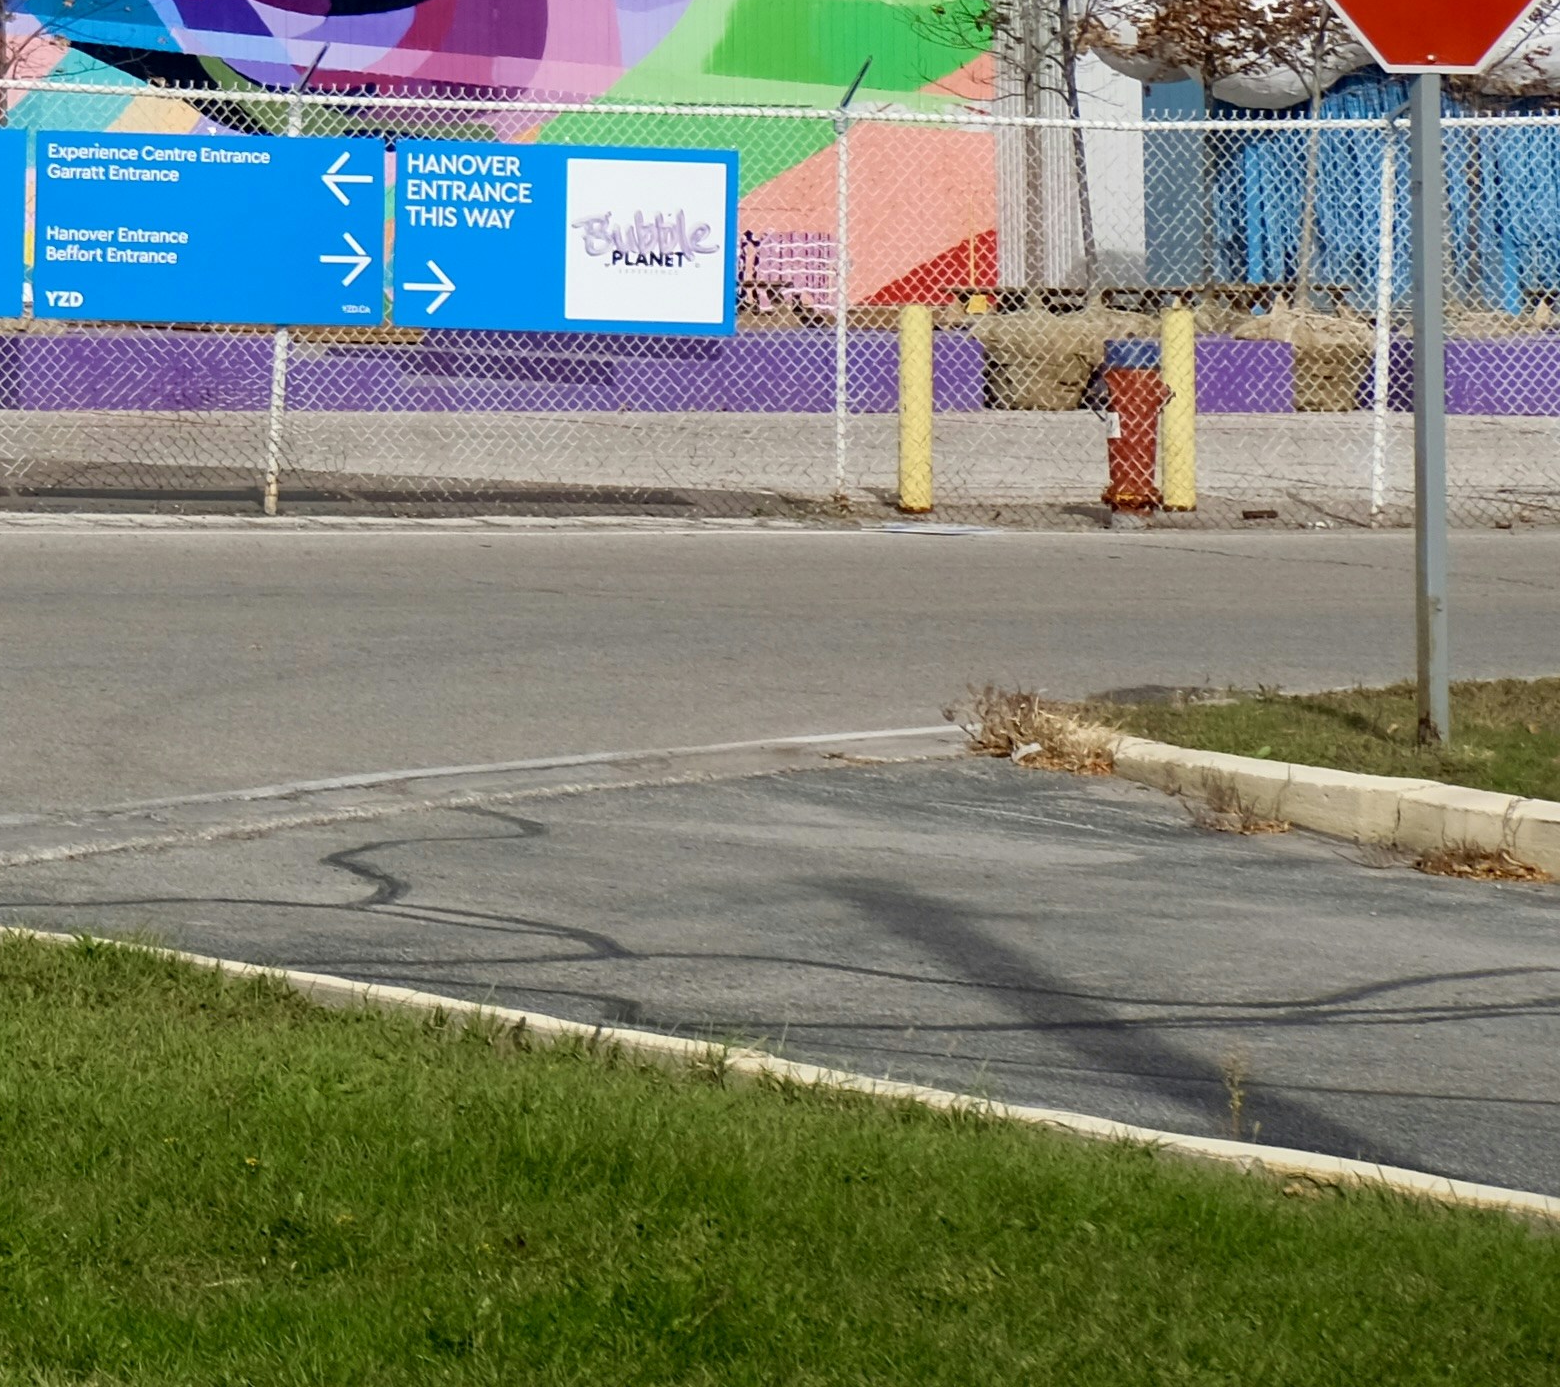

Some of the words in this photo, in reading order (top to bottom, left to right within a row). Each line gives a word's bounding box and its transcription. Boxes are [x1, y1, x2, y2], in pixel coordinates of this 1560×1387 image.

[47, 143, 139, 164] Experience
[141, 145, 198, 163] Centre
[200, 147, 271, 165] Entrance
[46, 165, 106, 180] Garratt
[108, 166, 180, 182] Entrance
[406, 153, 522, 177] HANOVER
[406, 180, 533, 204] ENTRANCE
[405, 205, 457, 228] THIS
[463, 208, 516, 230] WAY
[46, 226, 115, 243] Hanover
[117, 227, 190, 244] Entrance
[571, 208, 720, 262] Bubble
[46, 245, 103, 262] Beffort
[106, 247, 178, 264] Entrance
[611, 250, 686, 268] PLANET
[45, 291, 84, 308] YZD
